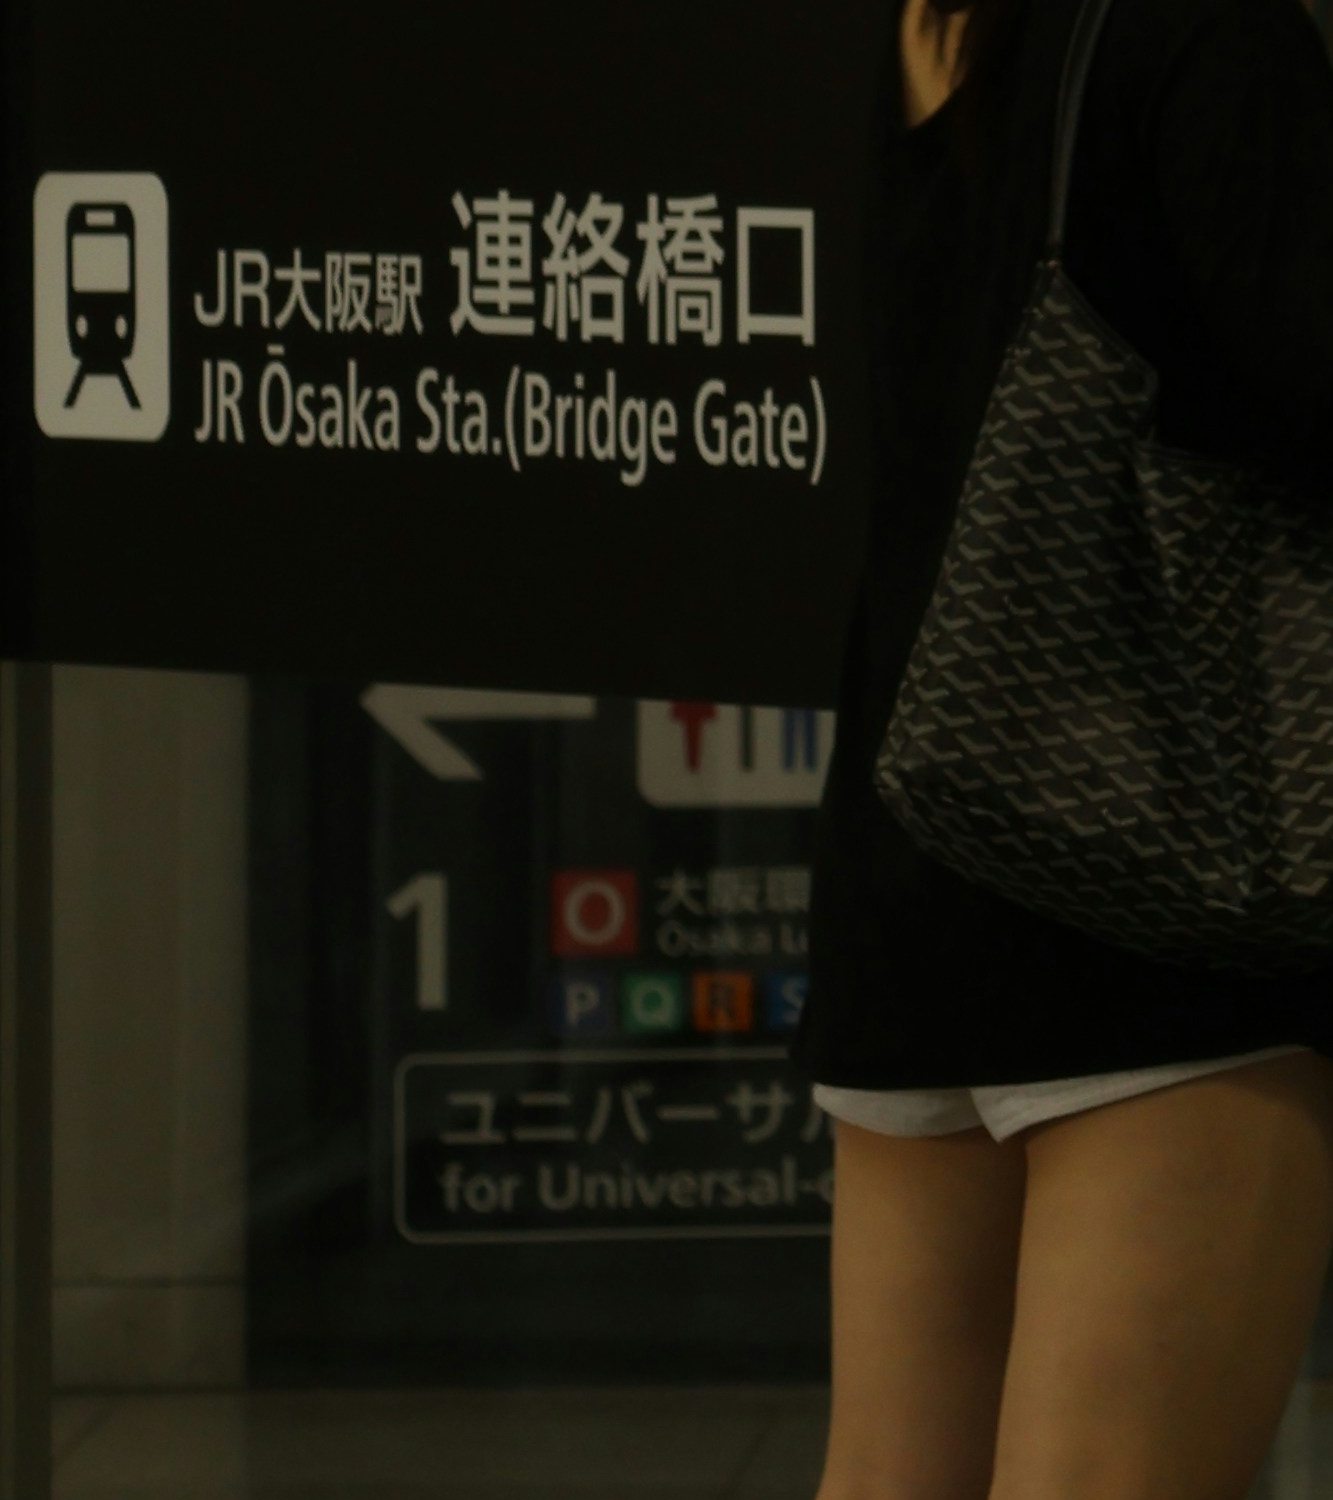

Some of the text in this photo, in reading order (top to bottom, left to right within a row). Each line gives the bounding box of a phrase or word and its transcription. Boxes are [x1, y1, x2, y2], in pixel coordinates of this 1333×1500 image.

[193, 188, 817, 347] JR大阪駅 連絡橋口
[194, 358, 246, 445] JR
[257, 343, 401, 452] Ōsaka
[691, 376, 828, 487] Gate)
[385, 871, 449, 1012] 1
[438, 1161, 522, 1216] for
